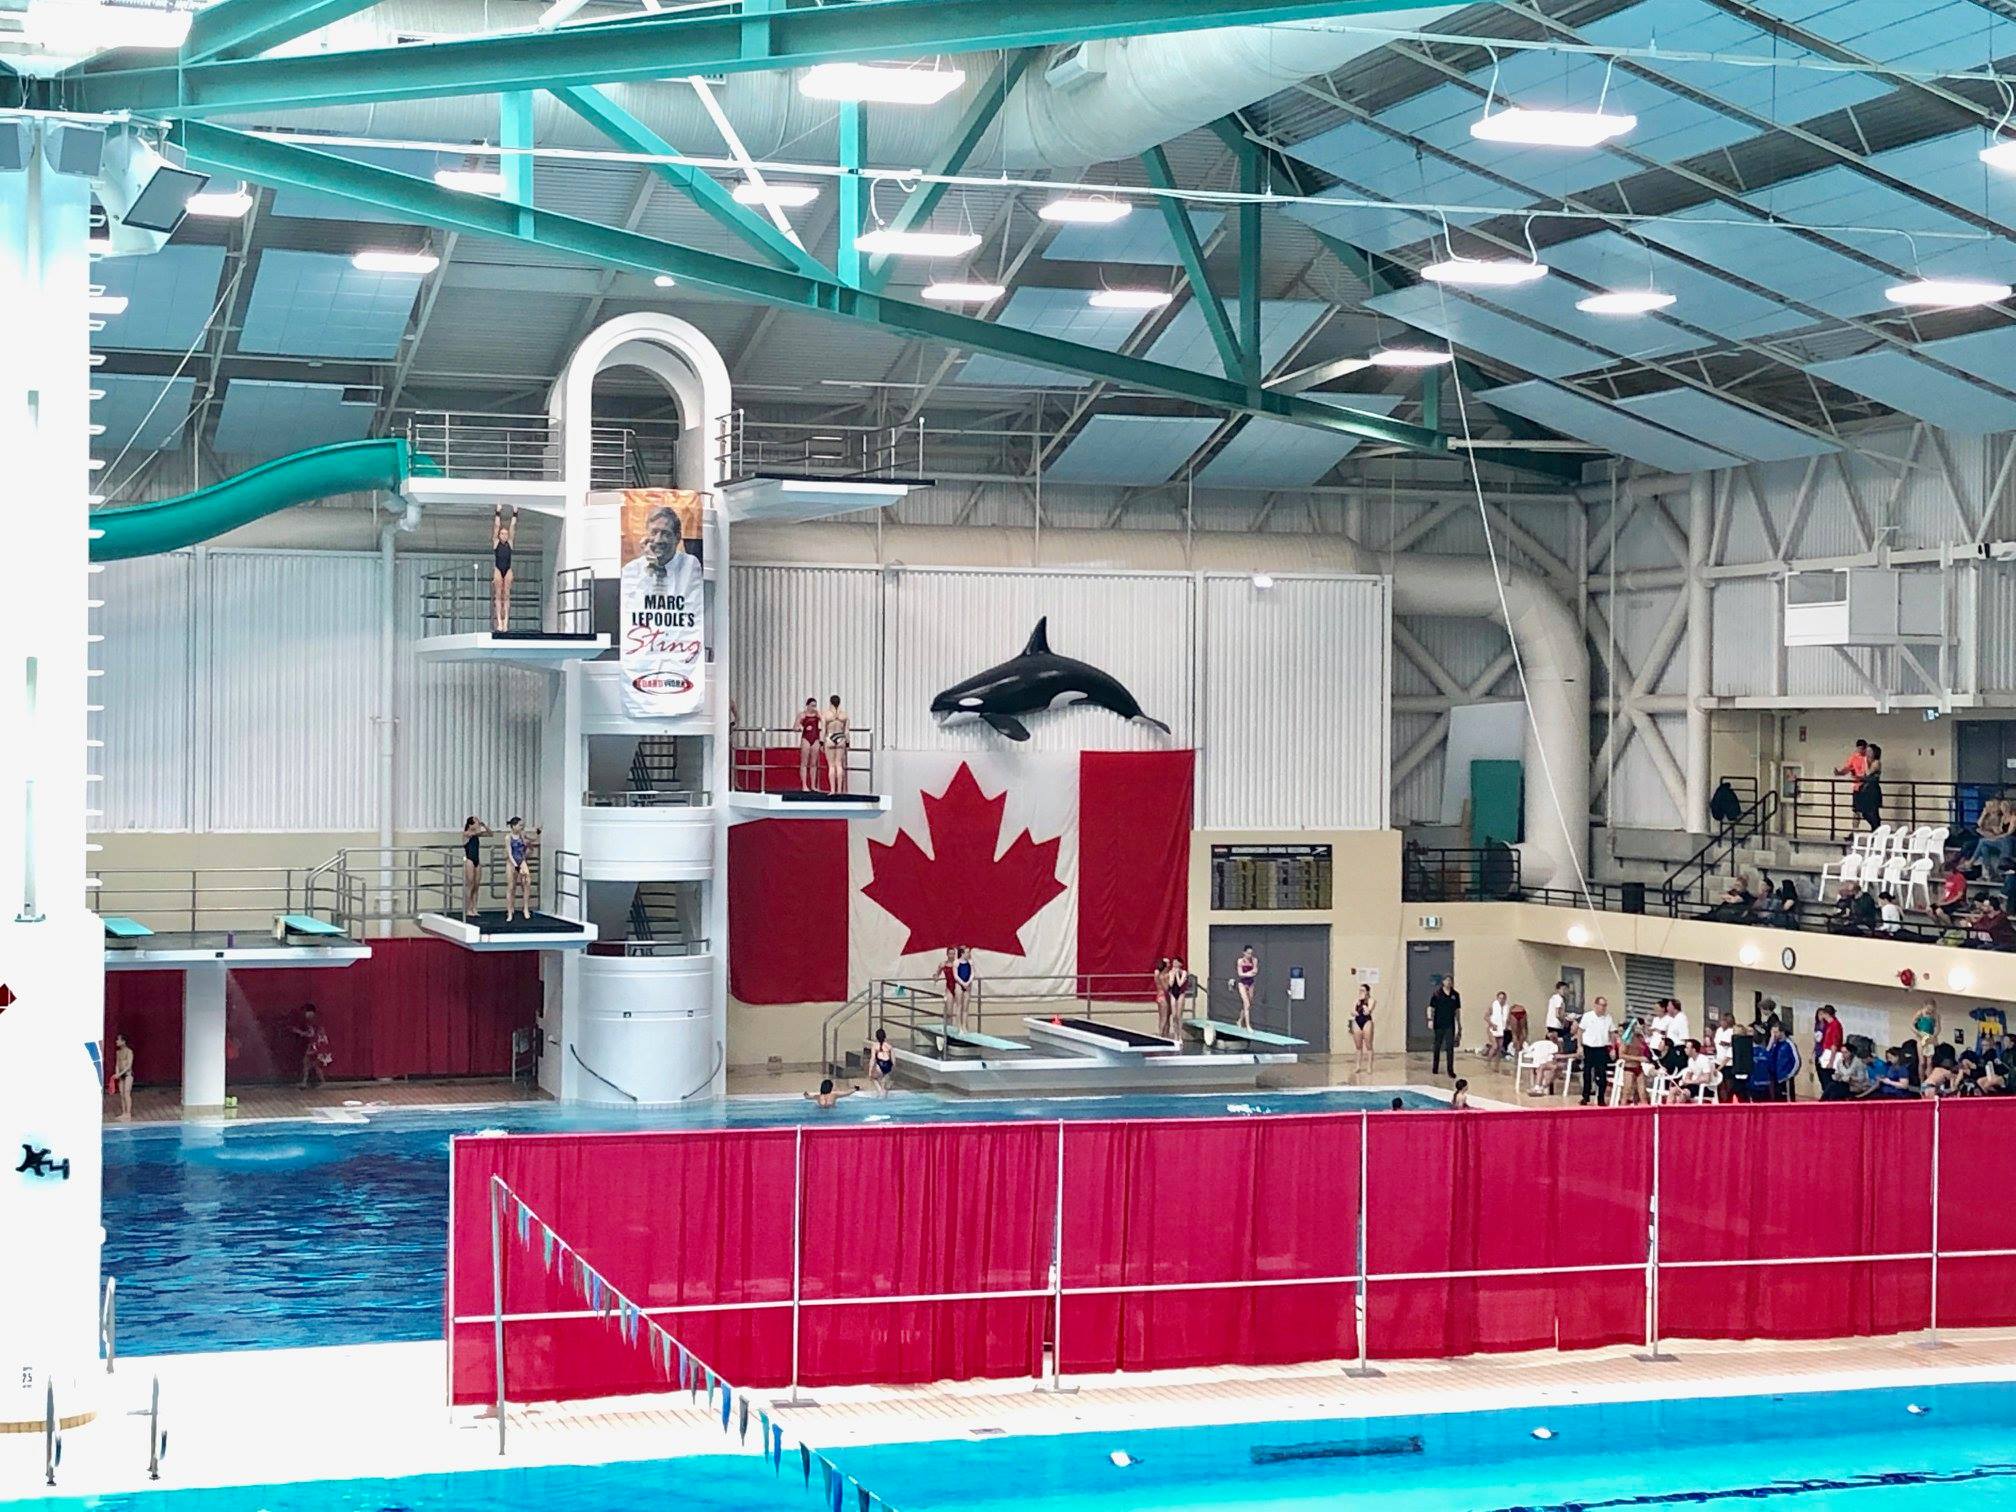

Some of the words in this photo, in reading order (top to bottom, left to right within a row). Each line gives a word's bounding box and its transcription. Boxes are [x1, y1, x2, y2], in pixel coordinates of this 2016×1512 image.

[644, 594, 685, 611] MARC
[632, 612, 695, 628] LEPOOLE'S
[625, 624, 702, 664] Sting
